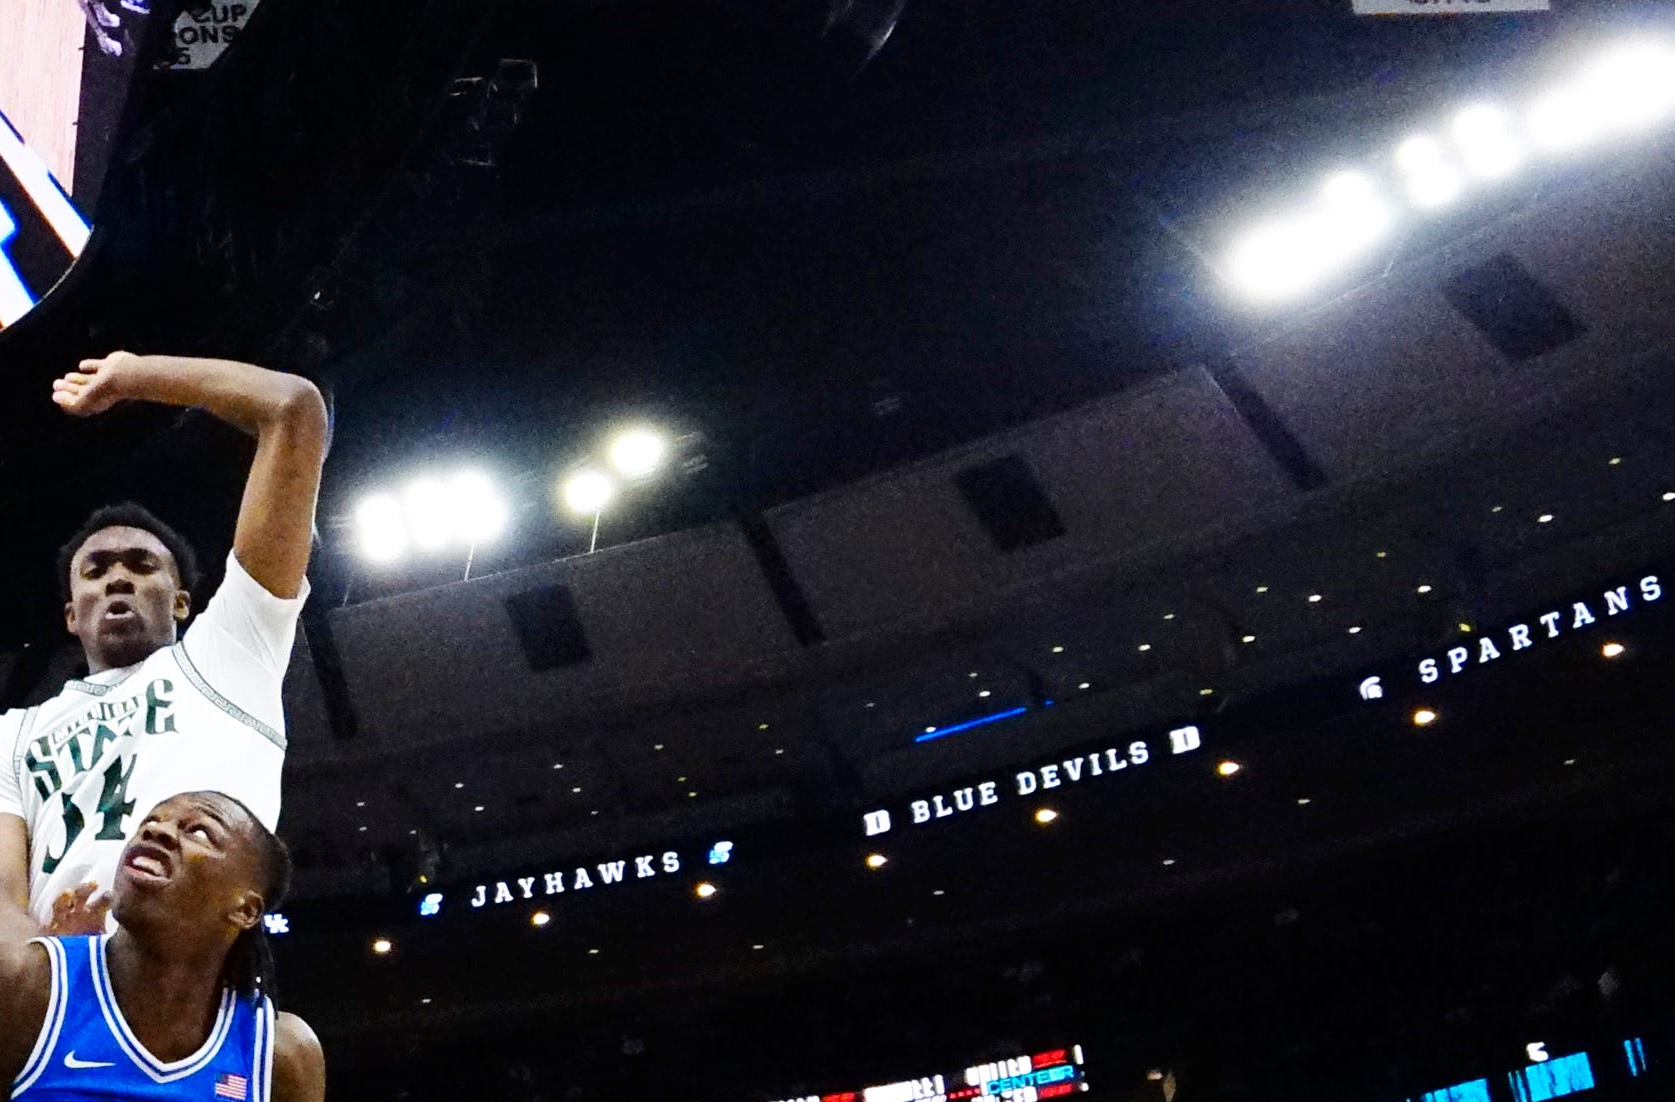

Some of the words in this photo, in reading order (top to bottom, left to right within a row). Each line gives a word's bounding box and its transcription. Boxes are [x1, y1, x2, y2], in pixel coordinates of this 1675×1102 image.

[1417, 574, 1663, 686] SPARTANS
[911, 781, 998, 826] BLUE
[1016, 740, 1150, 796] DEVILS
[471, 851, 681, 908] JAYHAWKS
